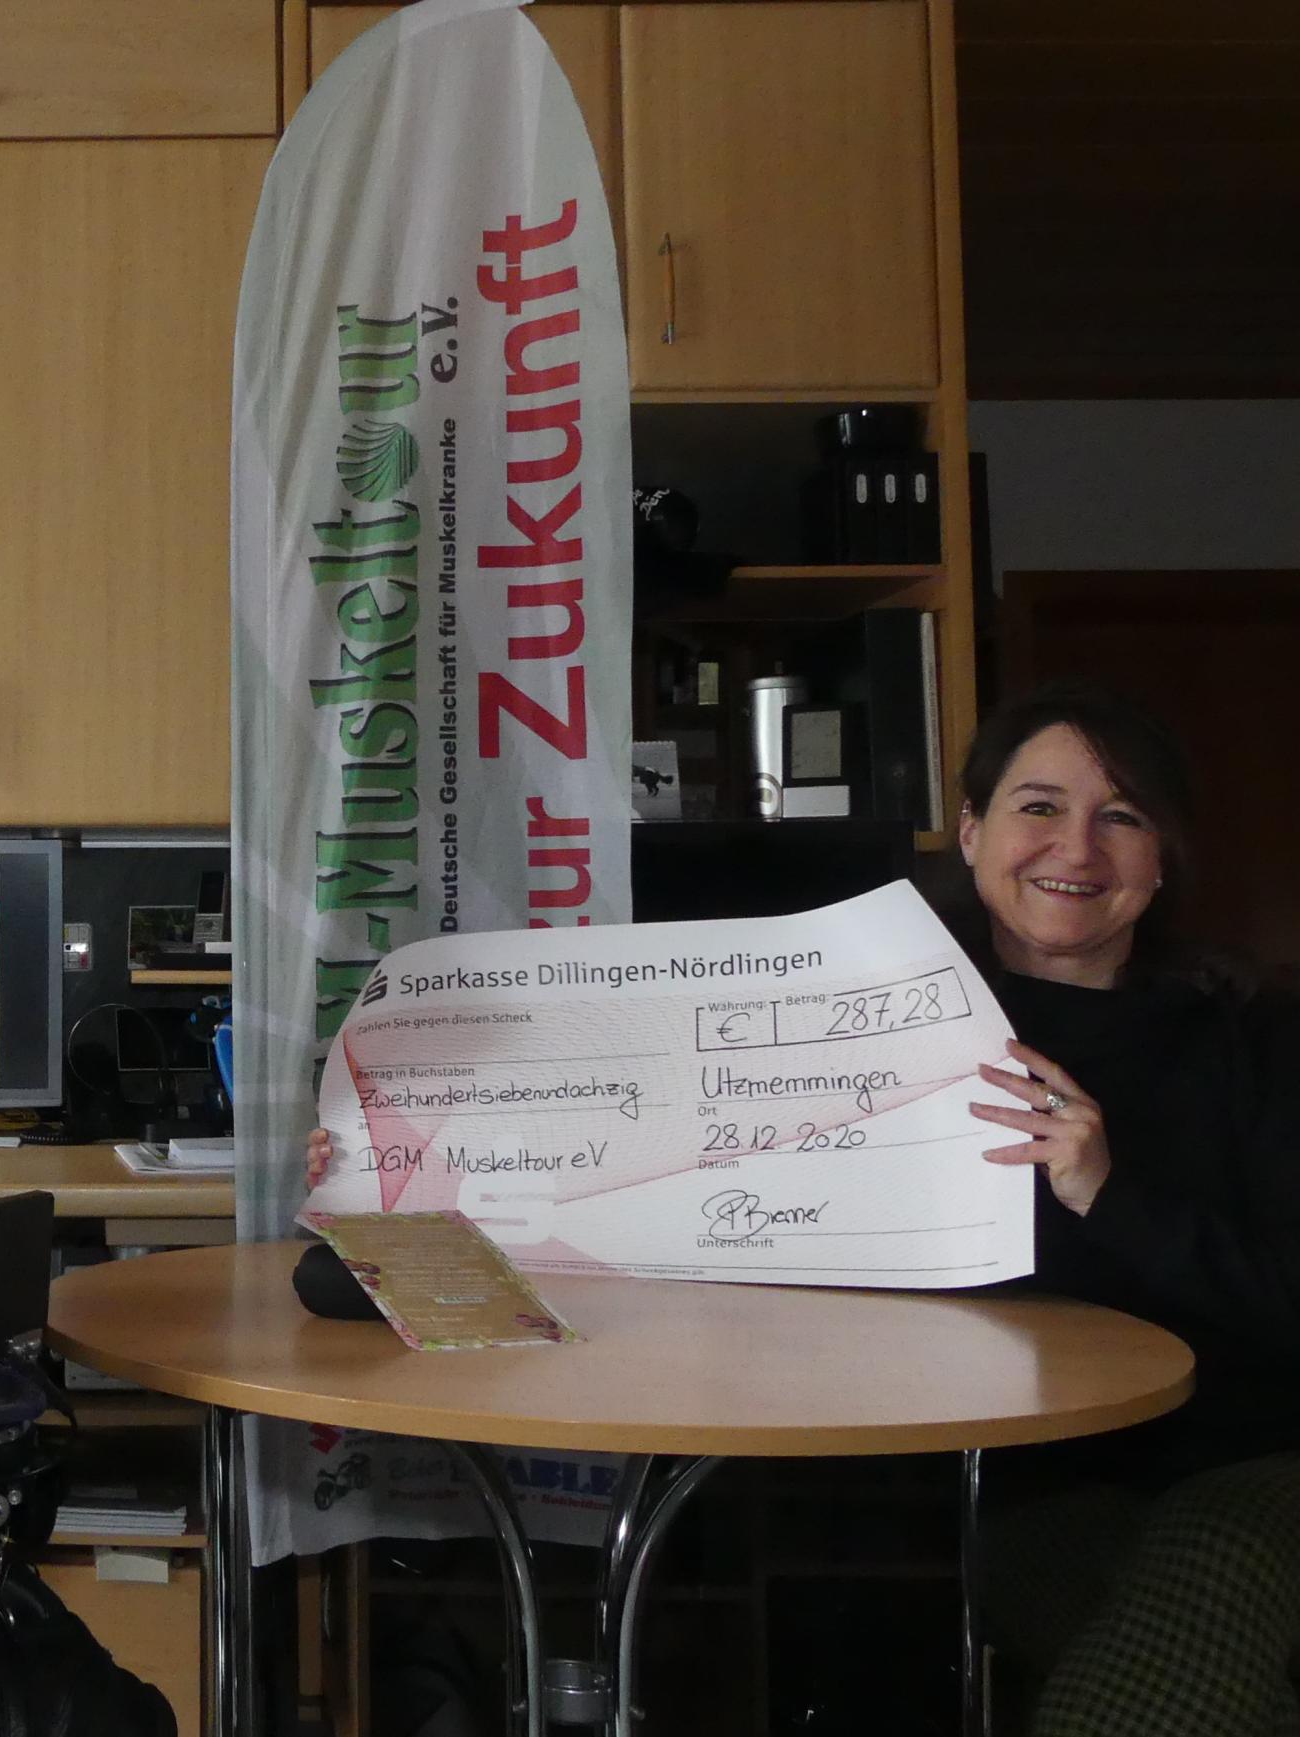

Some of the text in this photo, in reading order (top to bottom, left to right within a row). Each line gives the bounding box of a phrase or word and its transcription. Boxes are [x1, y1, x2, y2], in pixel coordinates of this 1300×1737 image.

[477, 198, 588, 760] Zukunft
[438, 417, 457, 593] Muskelkranke
[438, 601, 457, 637] für
[438, 645, 459, 804] Gesellschaft
[439, 812, 459, 932] Deutsche
[400, 967, 529, 997] Sparkasse
[538, 949, 823, 989] Dillingen-Nördlingen
[394, 1017, 413, 1029] Sie
[414, 1016, 450, 1029] gegen
[452, 1013, 491, 1025] diesen
[493, 1009, 533, 1024] Scheck
[826, 982, 944, 1036] 287,28
[356, 1065, 475, 1081] Betrag in Buchstaben
[698, 1106, 718, 1116] Ort
[357, 1144, 423, 1172] DGM
[447, 1145, 563, 1173] Muskeltour
[699, 1159, 740, 1169] Datum
[697, 1238, 775, 1249] Unterschrift
